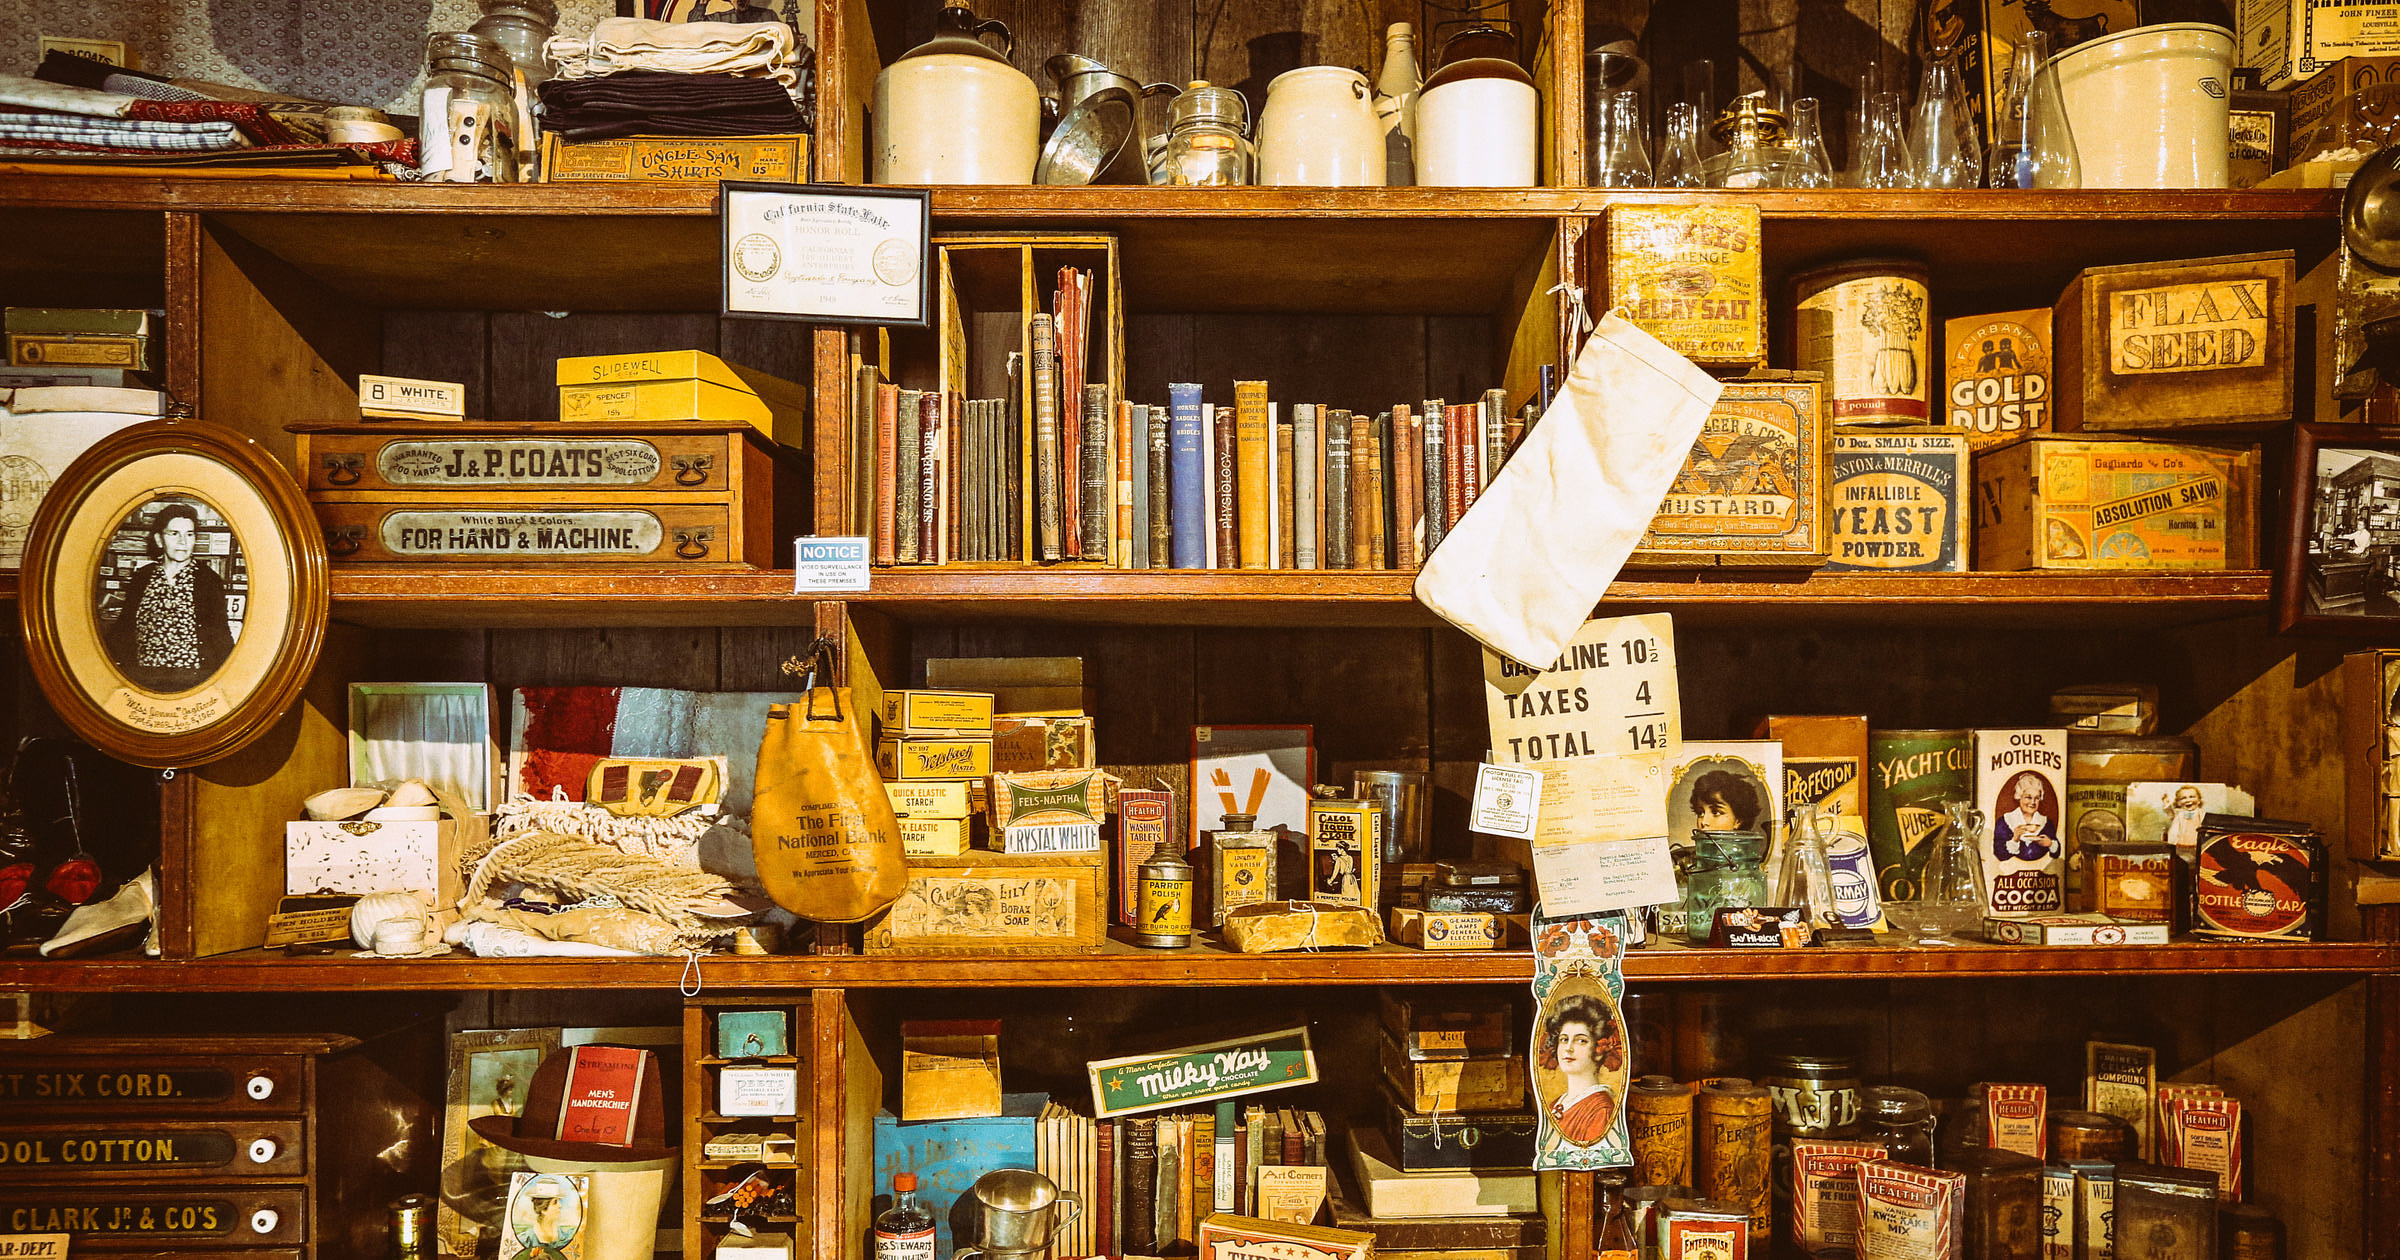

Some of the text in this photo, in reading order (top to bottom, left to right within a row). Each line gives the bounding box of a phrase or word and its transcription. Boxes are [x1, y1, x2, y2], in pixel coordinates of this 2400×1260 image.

[706, 150, 740, 171] SAM
[647, 164, 723, 179] SHIRTS
[752, 166, 766, 175] US
[1624, 299, 1750, 320] CELERY SALT
[2122, 283, 2267, 330] FLAX
[2122, 327, 2256, 371] SEED
[592, 359, 662, 380] SLIDEWELL
[373, 385, 384, 399] 8
[1951, 375, 2046, 407] GOLD
[1849, 402, 1885, 410] pounds
[1952, 402, 2045, 433] DUST
[1745, 423, 1753, 435] &
[1850, 438, 1871, 448] Doz.
[1875, 438, 1917, 448] SMALL
[1923, 438, 1954, 448] SIZE.
[393, 450, 442, 464] WARRANTED
[606, 450, 624, 462] BEST
[638, 451, 658, 464] CORD
[1464, 444, 1476, 484] ENGLISH
[393, 464, 441, 476] 200 YARDS
[606, 463, 656, 476] SPOOL COTTON
[1875, 456, 1952, 486] & MERRILL'S
[2095, 459, 2143, 470] Gagliardo
[922, 430, 934, 523] SECOND READER
[1218, 452, 1232, 529] PHYSIOLOGY
[1846, 486, 1921, 501] INFALLIBLE
[2095, 480, 2219, 526] ABSOLUTION SAVON
[461, 516, 526, 525] White Black
[1834, 507, 1938, 535] YEAST
[401, 528, 640, 549] FOR HAND & MACHINE.
[803, 546, 860, 558] NOTICE
[1842, 542, 1924, 557] POWDER.
[1504, 680, 1651, 719] TAXES 4
[1509, 731, 1595, 763] TOTAL
[2010, 735, 2045, 746] OUR
[918, 744, 974, 772] Welsbach
[1991, 749, 2061, 772] MOTHER'S
[1878, 751, 1944, 790] YACHT
[1785, 763, 1852, 806] PERFECTION
[893, 789, 946, 798] QUICK ELASTIC
[1019, 793, 1080, 808] FELS-NAPTHA
[906, 798, 934, 806] STARCH
[1128, 806, 1155, 816] HEALTH
[796, 813, 866, 830] The First
[1318, 814, 1353, 823] CALOL
[909, 824, 938, 832] ELASTIC
[1130, 823, 1160, 832] WASHING
[1319, 824, 1357, 832] LIQUID
[1901, 812, 1935, 843] PURE
[778, 829, 886, 850] National Bank
[1009, 825, 1099, 853] CRYSTAL WHITE
[1131, 832, 1161, 841] TABLETS
[1316, 832, 1355, 842] GLOSS
[2232, 835, 2289, 854] Eagle
[806, 850, 839, 859] MERCED,
[804, 869, 834, 877] Appreciate
[1998, 877, 2056, 888] ALL OCCASION
[931, 882, 1030, 906] CALLA LILY
[1994, 890, 2058, 905] COCOA
[1001, 903, 1031, 914] BORAX
[2199, 895, 2307, 912] BOTTLE CAPS
[300, 915, 347, 925] HOLDERS
[579, 1059, 635, 1070] STREAMLINE
[1126, 1060, 1179, 1074] Mars Confection
[1136, 1047, 1272, 1098] Milky Way
[1220, 1071, 1259, 1082] CHOCOLATE
[2098, 1073, 2146, 1085] COMPOUND
[36, 1073, 182, 1097] SIX CORD.
[1195, 1086, 1212, 1095] crave
[1214, 1083, 1230, 1093] good
[588, 1090, 615, 1098] MEN'S
[571, 1099, 630, 1110] HANDKERCHIEF
[2000, 1105, 2027, 1114] HEALTH
[2186, 1115, 2217, 1125] HEALTH
[62, 1140, 179, 1162] COTTON.
[1808, 1160, 1857, 1171] HEALTH
[1262, 1170, 1323, 1180] Art Corners
[1810, 1180, 1834, 1190] LEMON
[1821, 1192, 1832, 1200] PIE
[1869, 1183, 1919, 1202] HEALTH
[12, 1207, 218, 1230] CLARK & CO'S
[1885, 1206, 1917, 1218] VANILLA
[1889, 1225, 1910, 1235] MIX
[1900, 1216, 1929, 1230] KAKE
[890, 1241, 932, 1250] STEWART'S
[1685, 1238, 1729, 1252] ENTERPRISE
